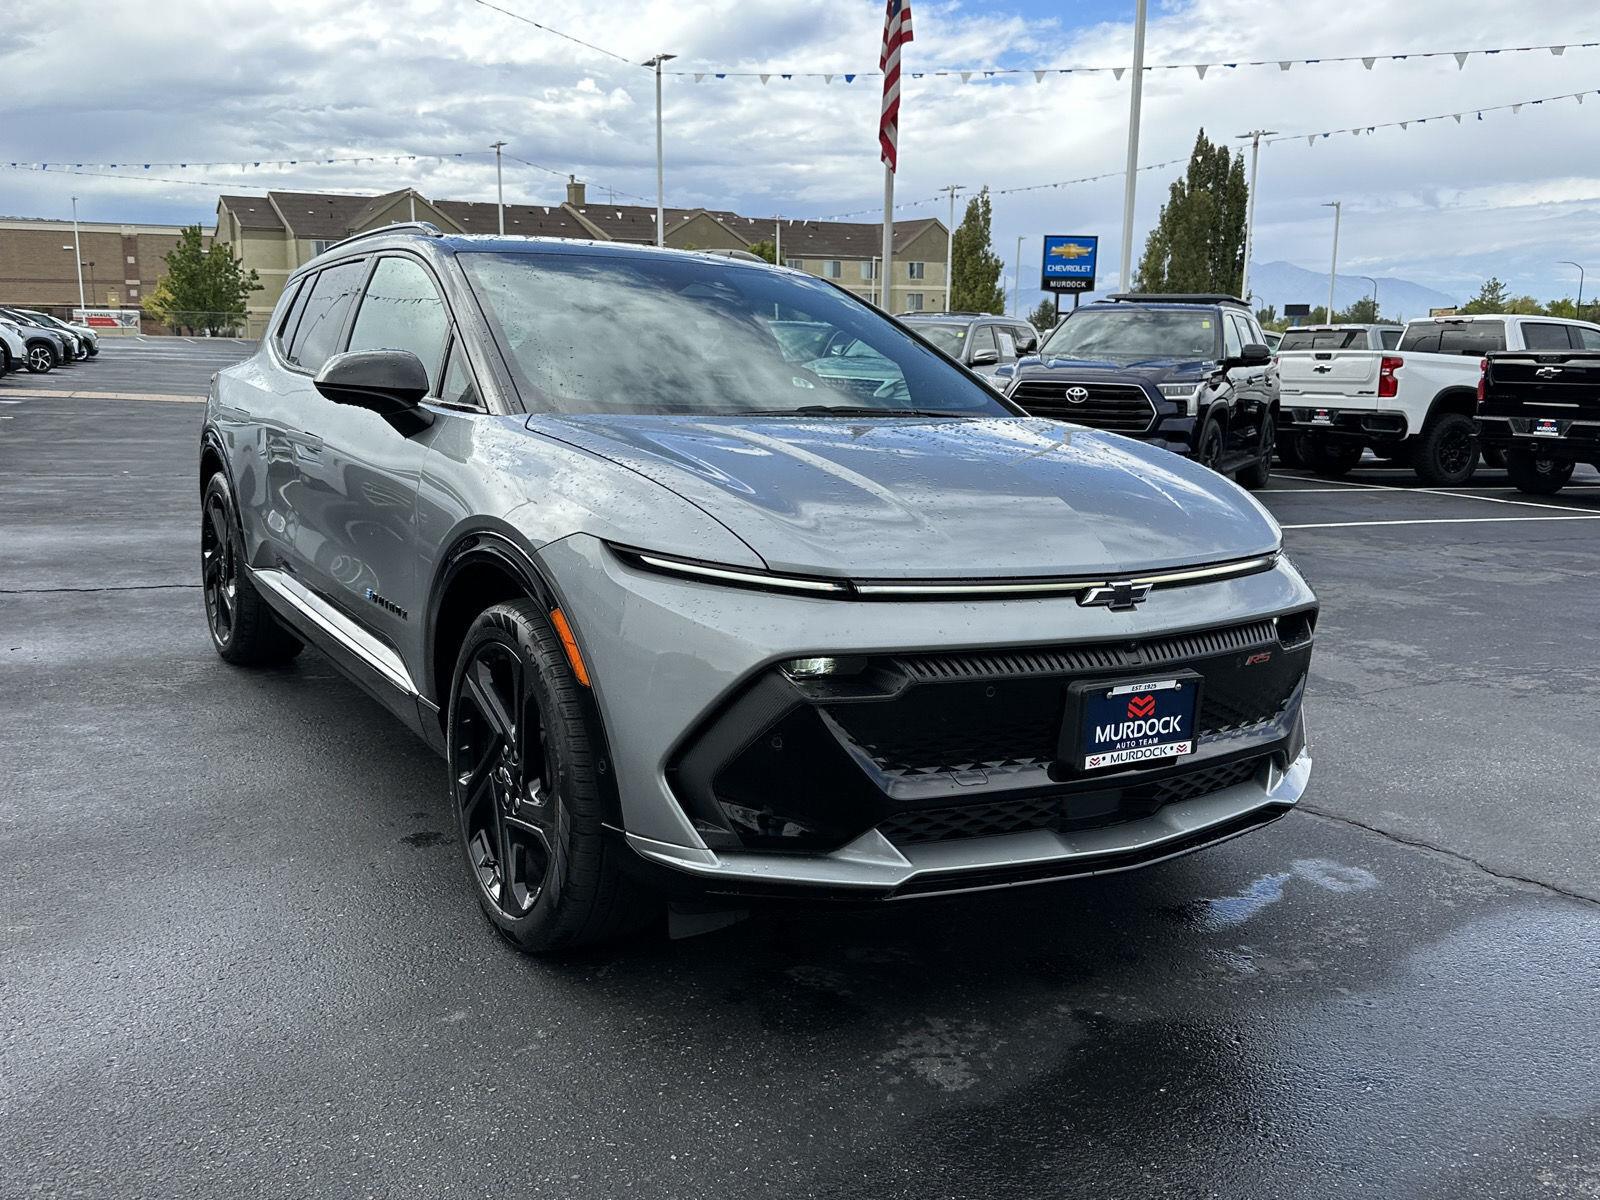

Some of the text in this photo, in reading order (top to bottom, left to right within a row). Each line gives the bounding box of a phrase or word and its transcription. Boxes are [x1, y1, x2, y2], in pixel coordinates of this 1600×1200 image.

[1047, 264, 1091, 273] CHEVROLET
[1050, 280, 1086, 288] MURDOCK
[1095, 714, 1182, 744] MURDOCK
[1115, 737, 1159, 750] AUTO TEAM
[1110, 745, 1168, 764] MURDOCK
